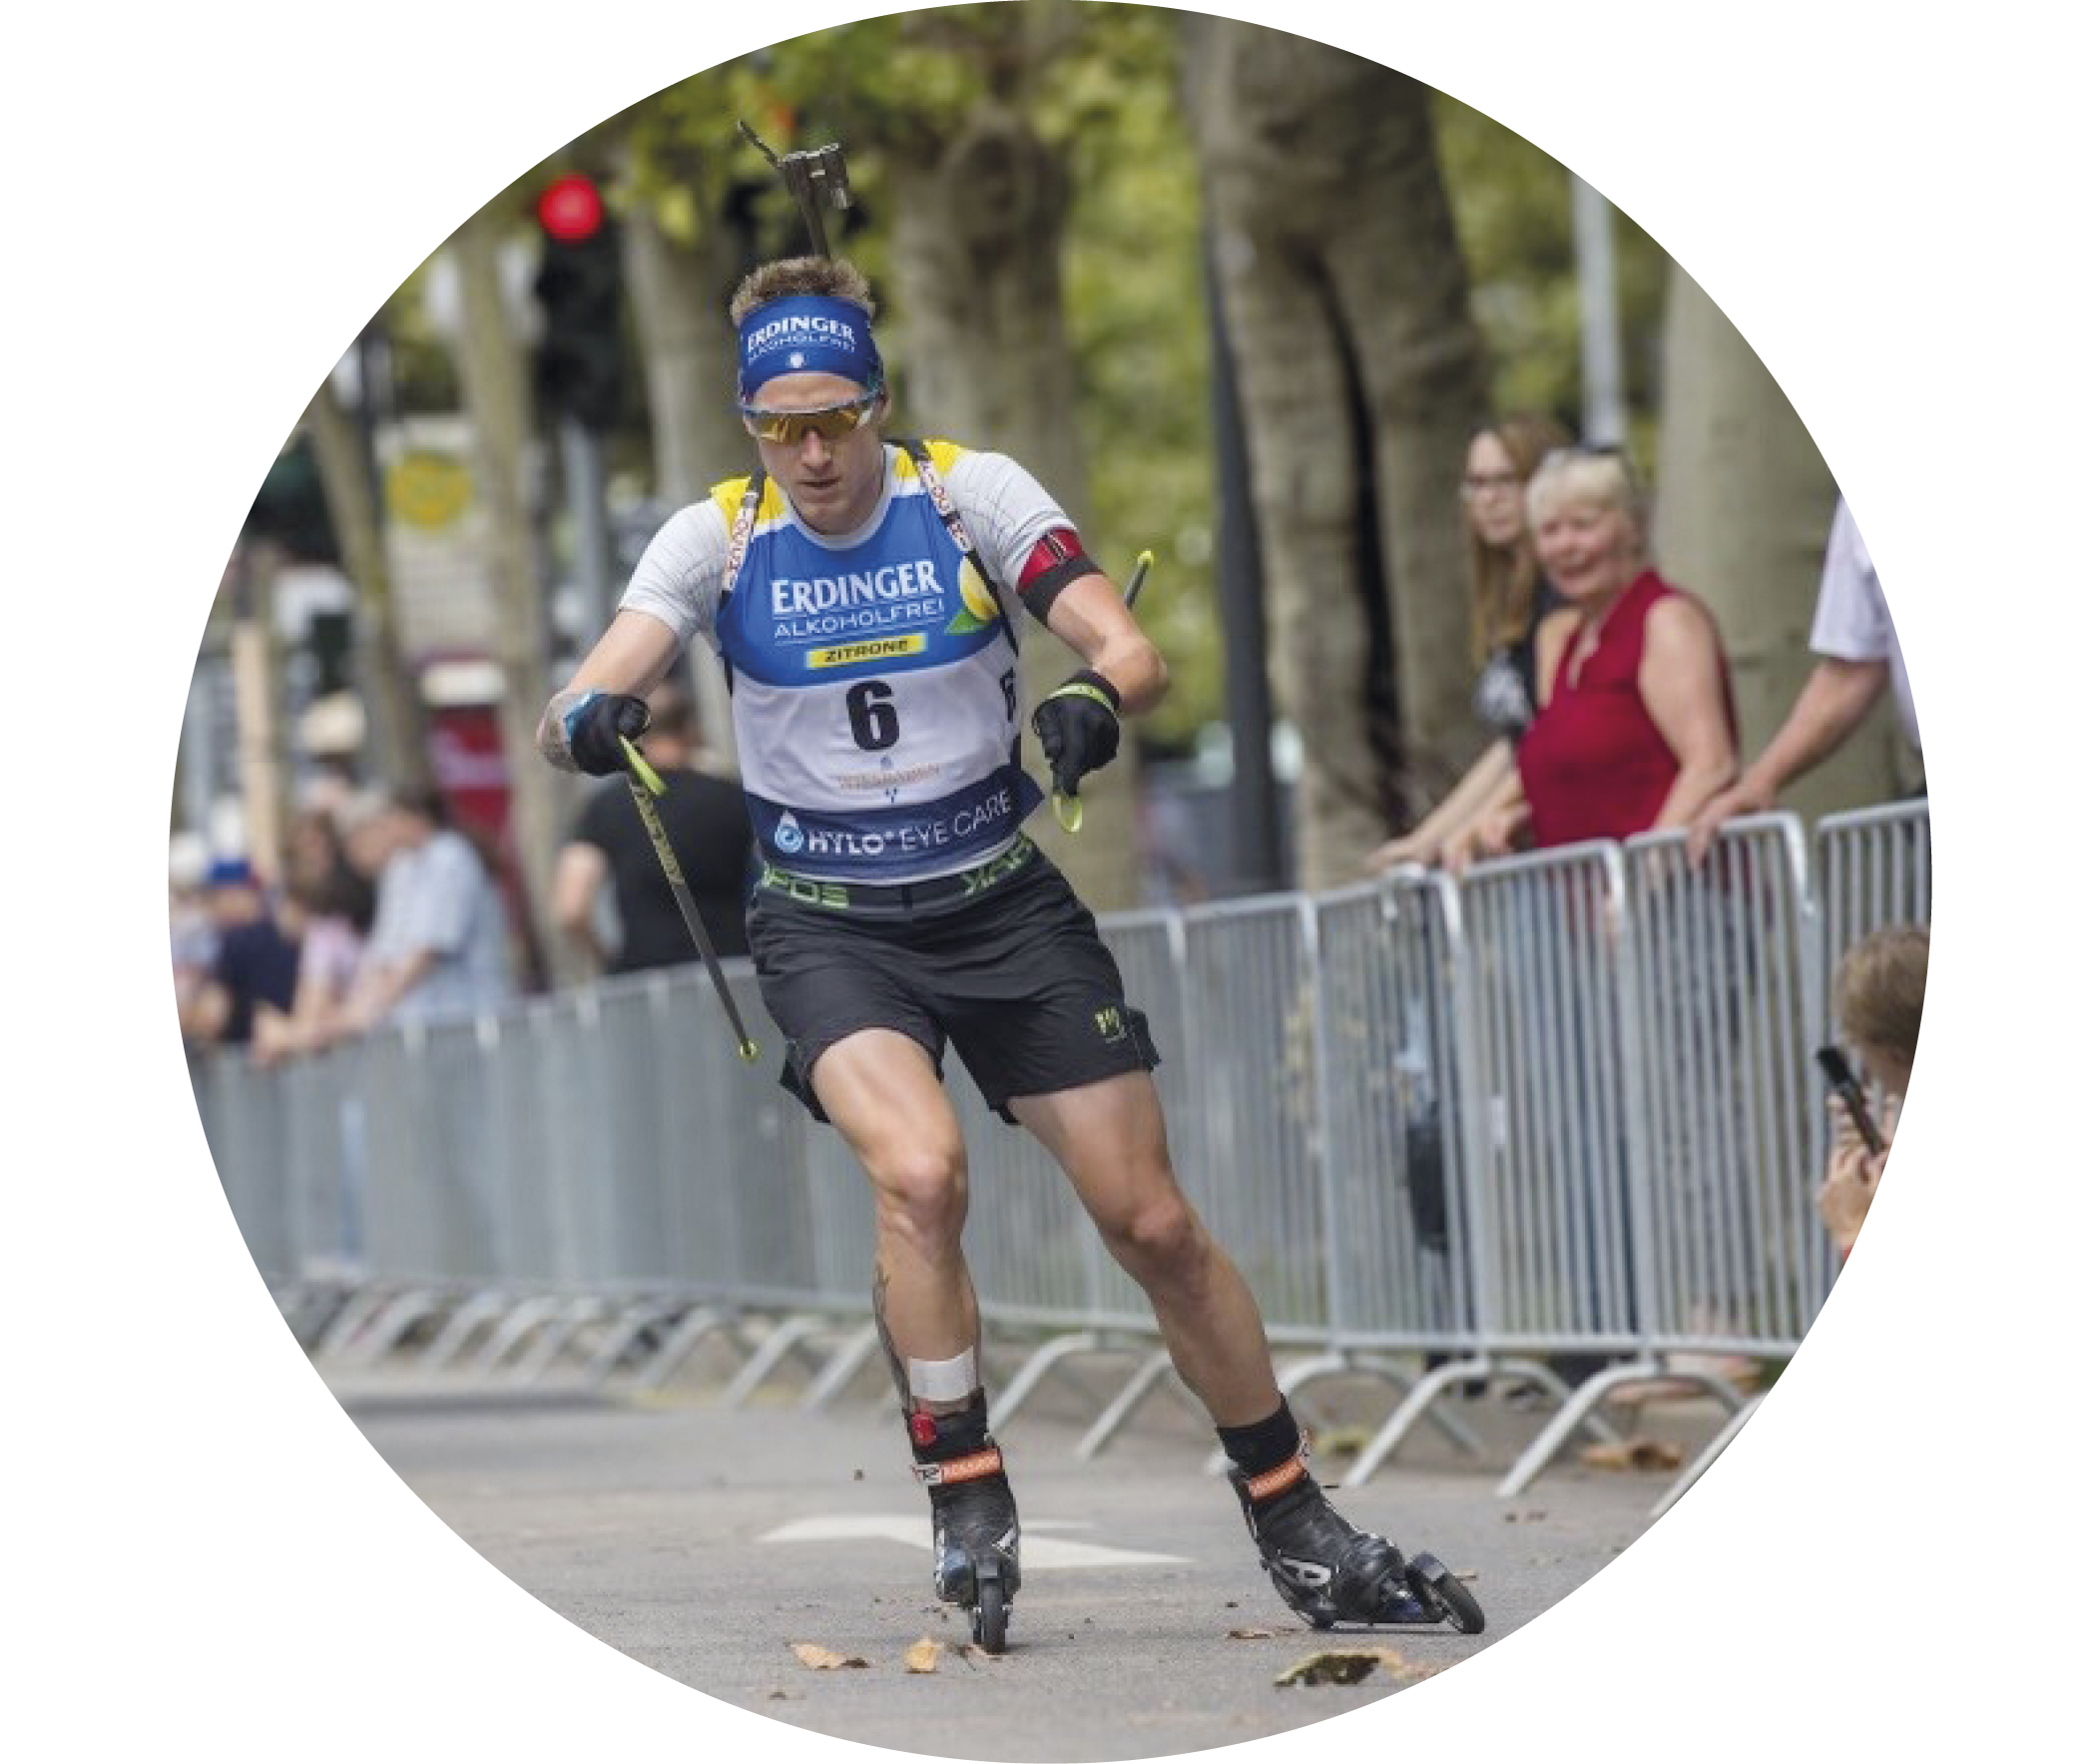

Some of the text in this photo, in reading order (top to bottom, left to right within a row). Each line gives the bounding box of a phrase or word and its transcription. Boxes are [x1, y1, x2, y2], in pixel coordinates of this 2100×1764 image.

[749, 315, 856, 353] ERDINGER
[771, 560, 944, 614] ERDINGER
[774, 598, 944, 639] ALKOHOLFREI
[824, 640, 908, 663] ZITRONE
[846, 680, 899, 750] 6
[899, 821, 949, 852] EYE
[954, 788, 1011, 837] CARE
